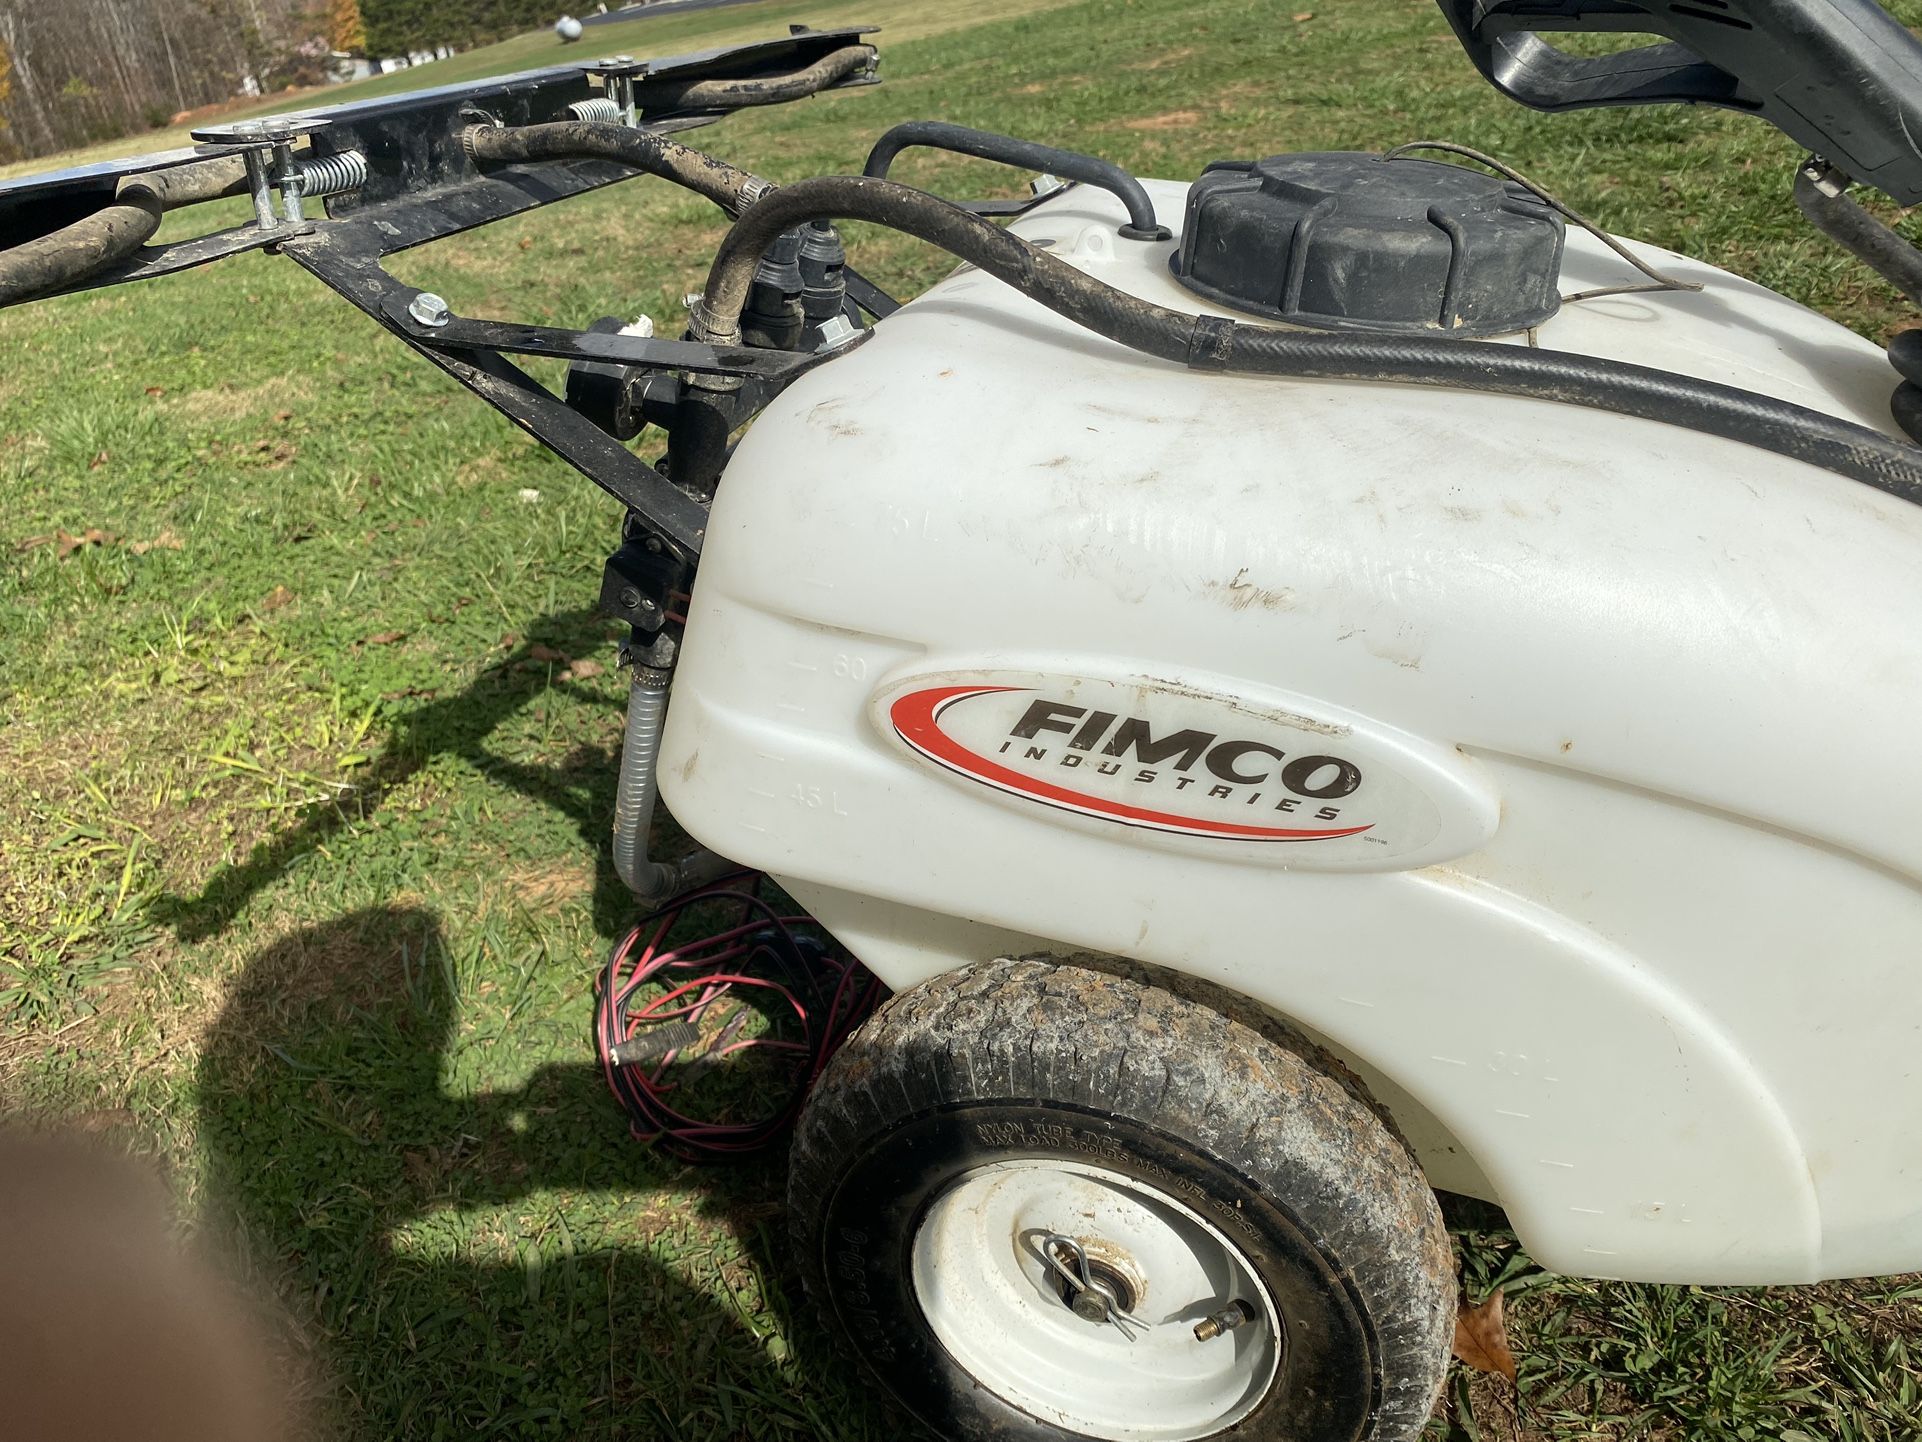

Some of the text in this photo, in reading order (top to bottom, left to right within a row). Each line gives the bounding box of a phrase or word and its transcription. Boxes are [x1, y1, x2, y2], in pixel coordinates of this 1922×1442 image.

[998, 741, 1341, 821] INDUSTRIES
[1010, 699, 1362, 799] FIMCO
[976, 1120, 1123, 1151] NYLON TUBE TYPE
[980, 1134, 1014, 1147] MAX
[1020, 1134, 1061, 1148] LOAD
[1136, 1157, 1170, 1180] MAX
[1175, 1175, 1209, 1201] INFL
